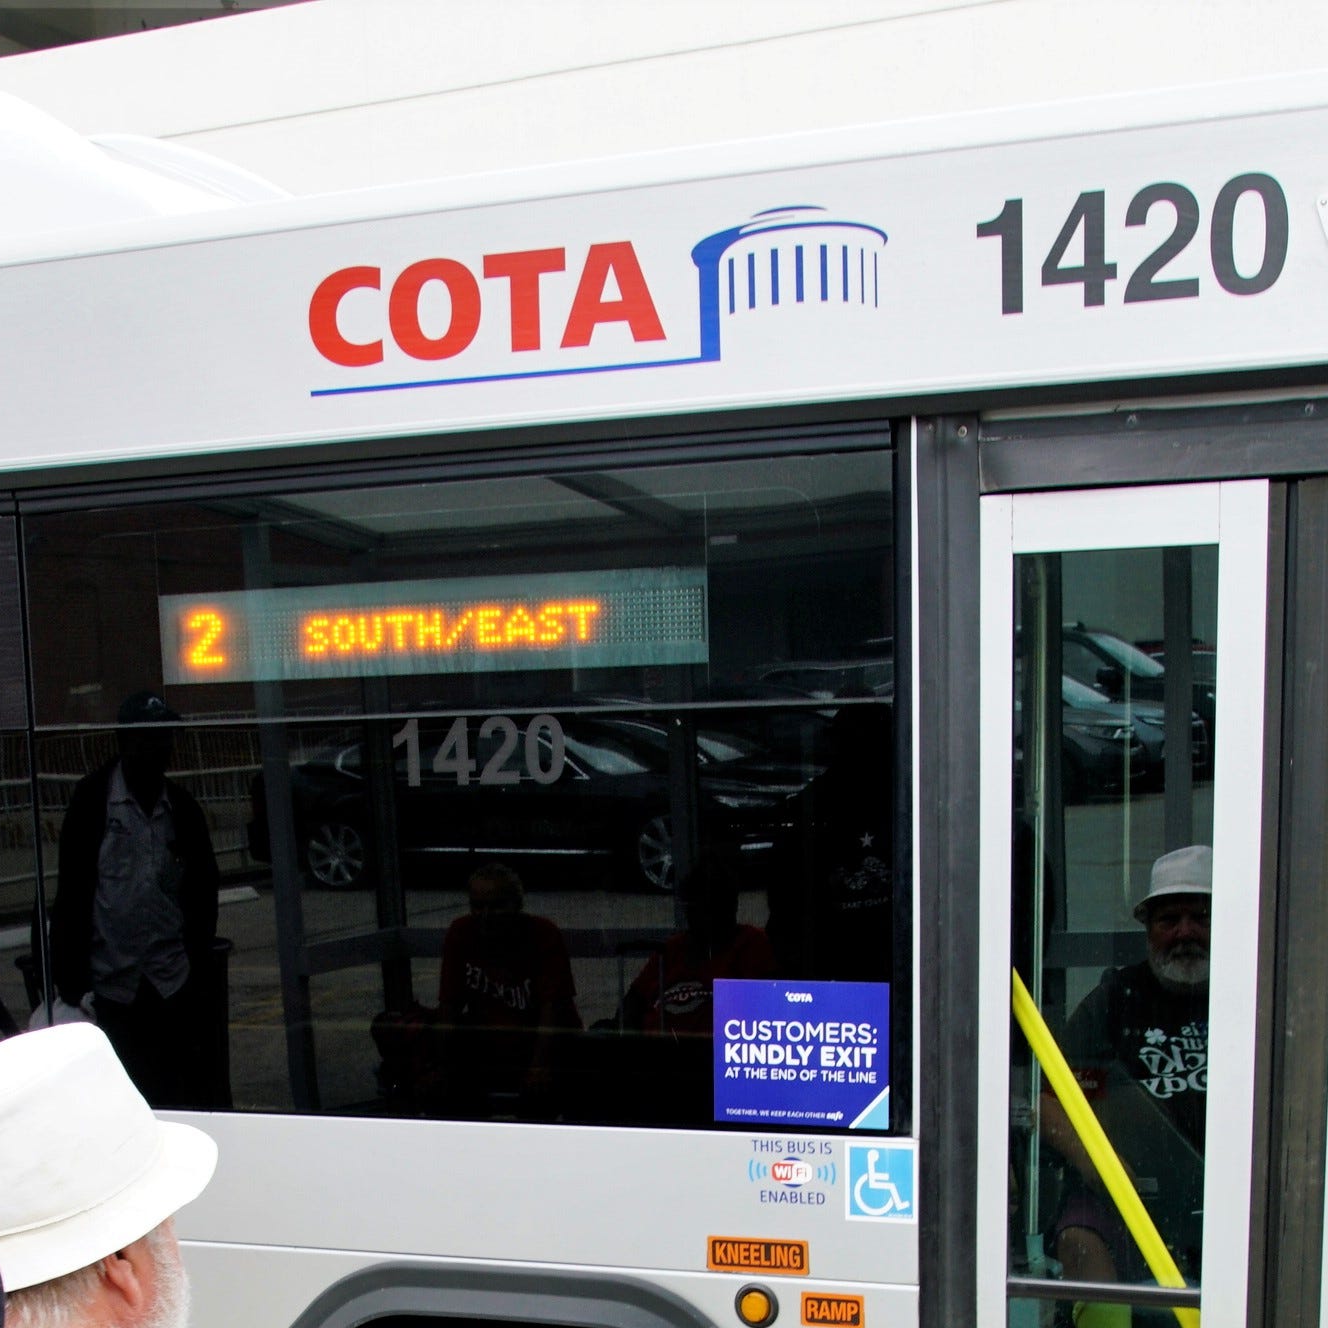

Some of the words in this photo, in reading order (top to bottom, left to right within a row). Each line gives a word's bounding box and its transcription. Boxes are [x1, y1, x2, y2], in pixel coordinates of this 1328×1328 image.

[976, 172, 1290, 316] 1420
[308, 240, 667, 368] COTA
[186, 613, 224, 666] 2
[306, 602, 598, 653] SOUTH/EAST
[392, 714, 565, 787] 1420
[724, 1019, 878, 1045] CUSTOMERS:
[724, 1043, 814, 1066] KINDLY
[820, 1045, 878, 1068] EXIT
[724, 1066, 741, 1079] AT
[743, 1067, 768, 1080] THE
[770, 1067, 797, 1081] END
[799, 1069, 818, 1082] OF
[820, 1070, 846, 1083] THE
[848, 1071, 878, 1084] LINE
[752, 1139, 783, 1153] THIS
[787, 1140, 815, 1154] BUS
[819, 1142, 833, 1155] IS
[760, 1190, 826, 1205] ENABLED
[715, 1241, 801, 1268] KNEELING
[806, 1300, 859, 1323] RAMP
